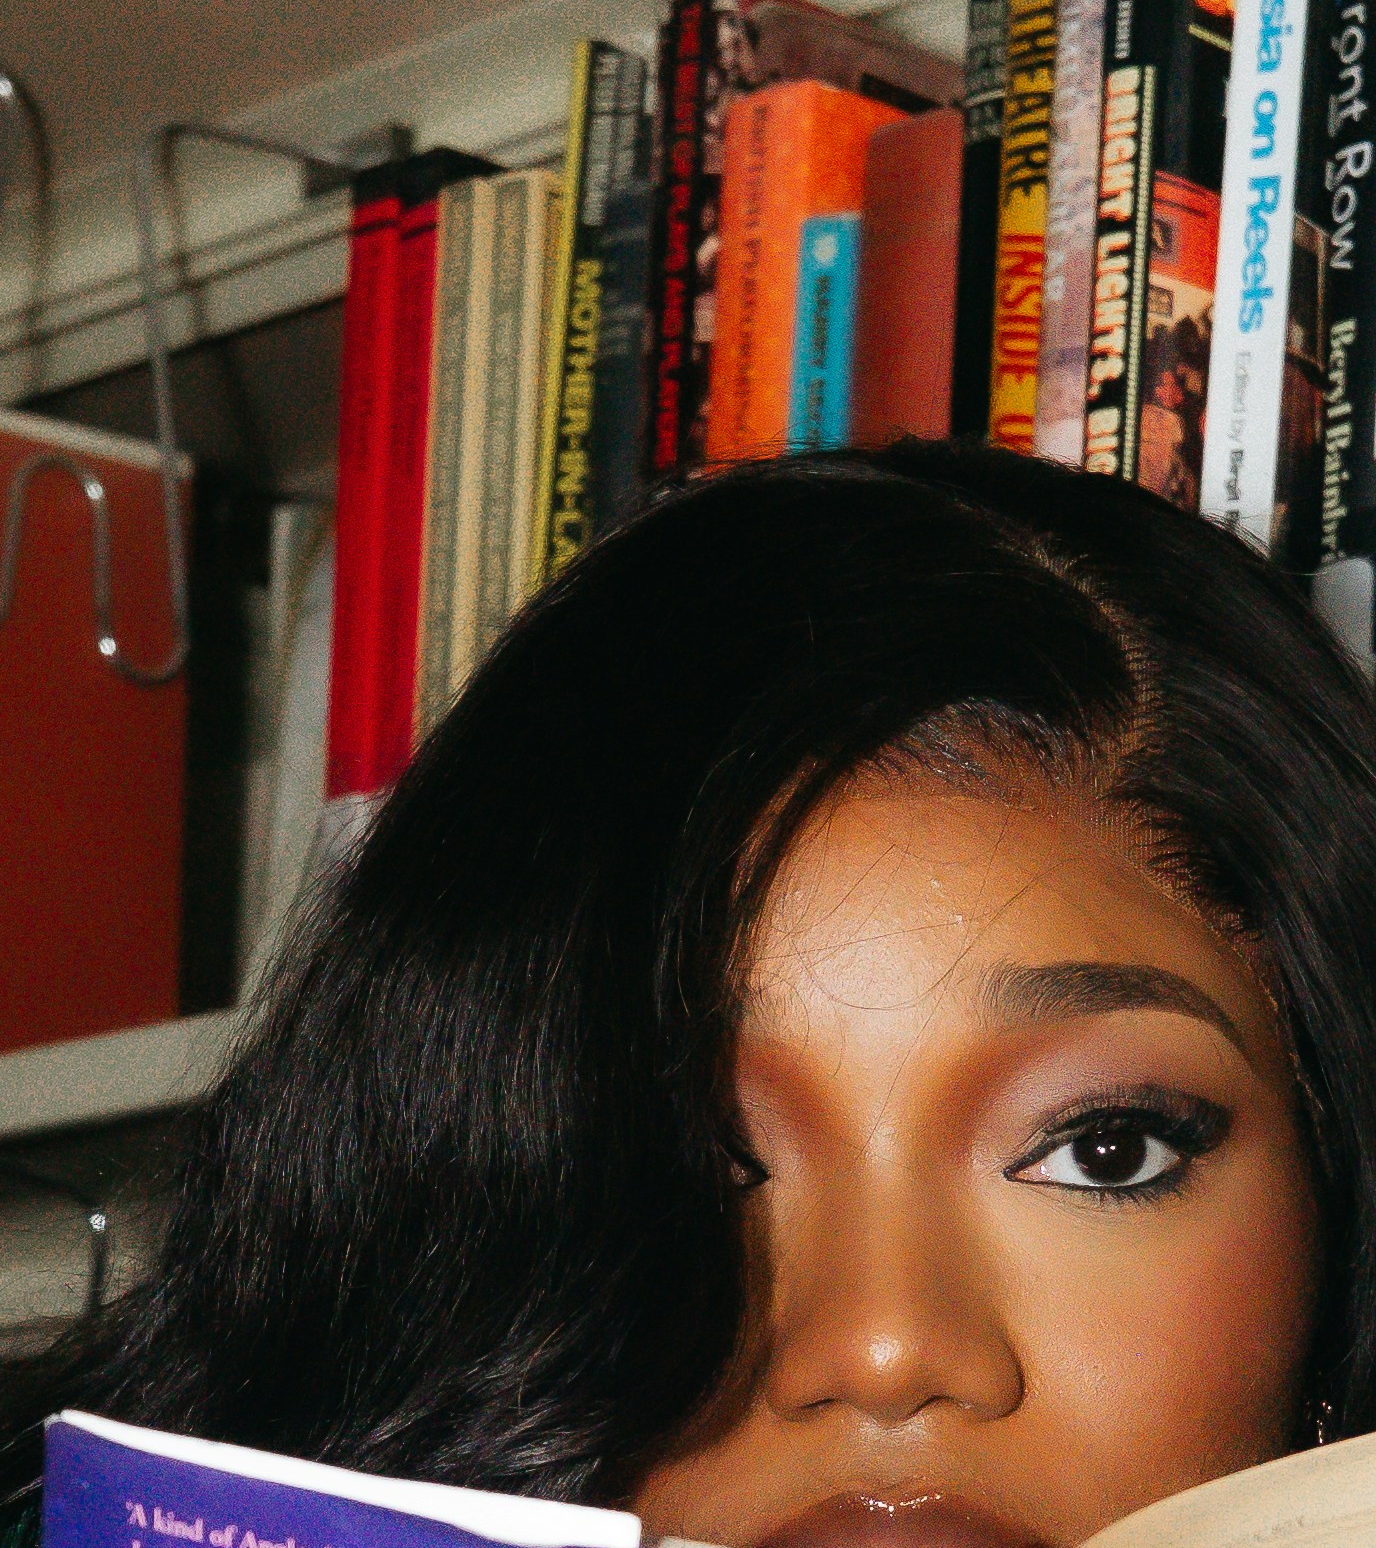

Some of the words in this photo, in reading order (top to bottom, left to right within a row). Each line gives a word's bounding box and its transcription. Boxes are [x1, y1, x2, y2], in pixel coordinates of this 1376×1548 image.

[1100, 66, 1140, 222] BRIGHT
[1251, 88, 1280, 161] on
[1238, 173, 1282, 336] Reels
[1330, 139, 1373, 270] Row
[996, 234, 1044, 383] INSIDE
[1324, 318, 1356, 420] Beryl
